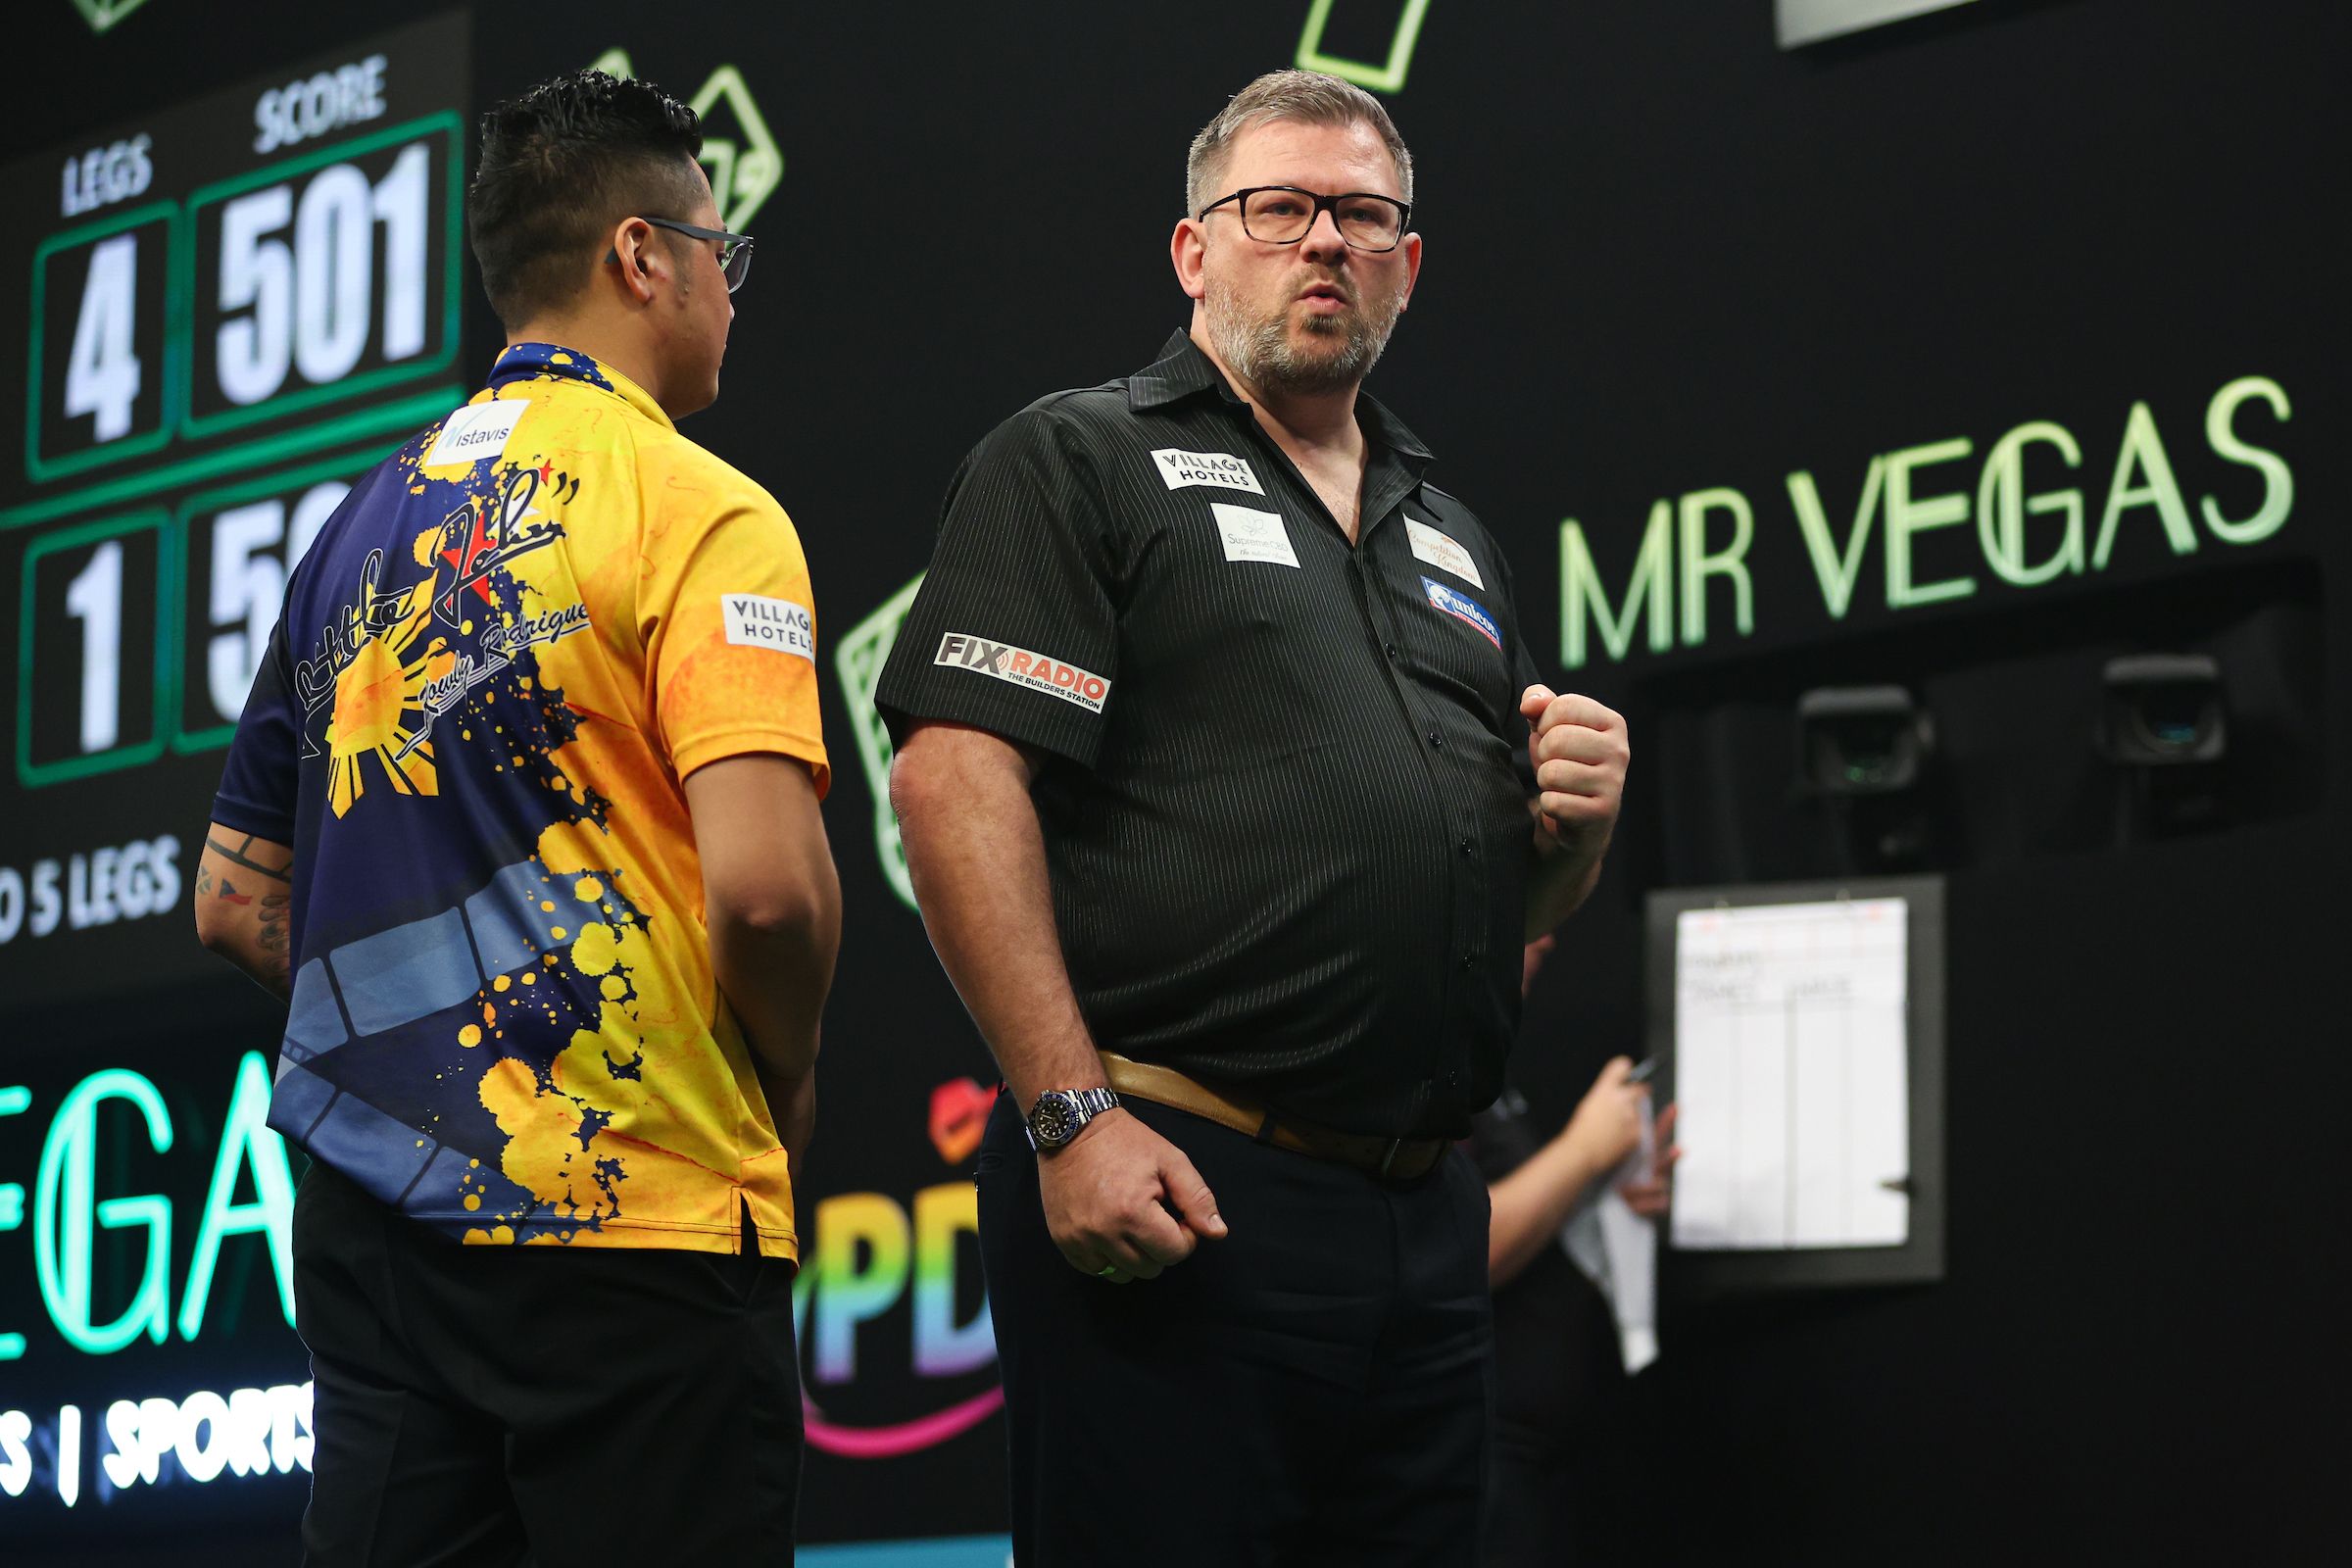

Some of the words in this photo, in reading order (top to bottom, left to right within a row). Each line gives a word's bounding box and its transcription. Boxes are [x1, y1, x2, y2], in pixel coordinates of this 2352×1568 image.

[254, 54, 388, 154] SCORE
[62, 133, 154, 218] LEGS
[65, 233, 141, 443] 4
[216, 142, 431, 406] 501
[1163, 454, 1248, 474] VILLAGE
[1180, 470, 1250, 486] HOTELS
[1560, 487, 1753, 668] MR
[1786, 375, 2294, 618] VEGAS
[66, 540, 123, 754] 1
[732, 601, 810, 630] VILLAG
[938, 635, 1007, 674] FIX
[1010, 651, 1105, 699] RADIO
[1007, 672, 1024, 682] THE
[1025, 675, 1065, 695] BUILDERS
[1066, 692, 1101, 710] STATION
[29, 858, 62, 938] 5
[68, 834, 182, 930] LEGS
